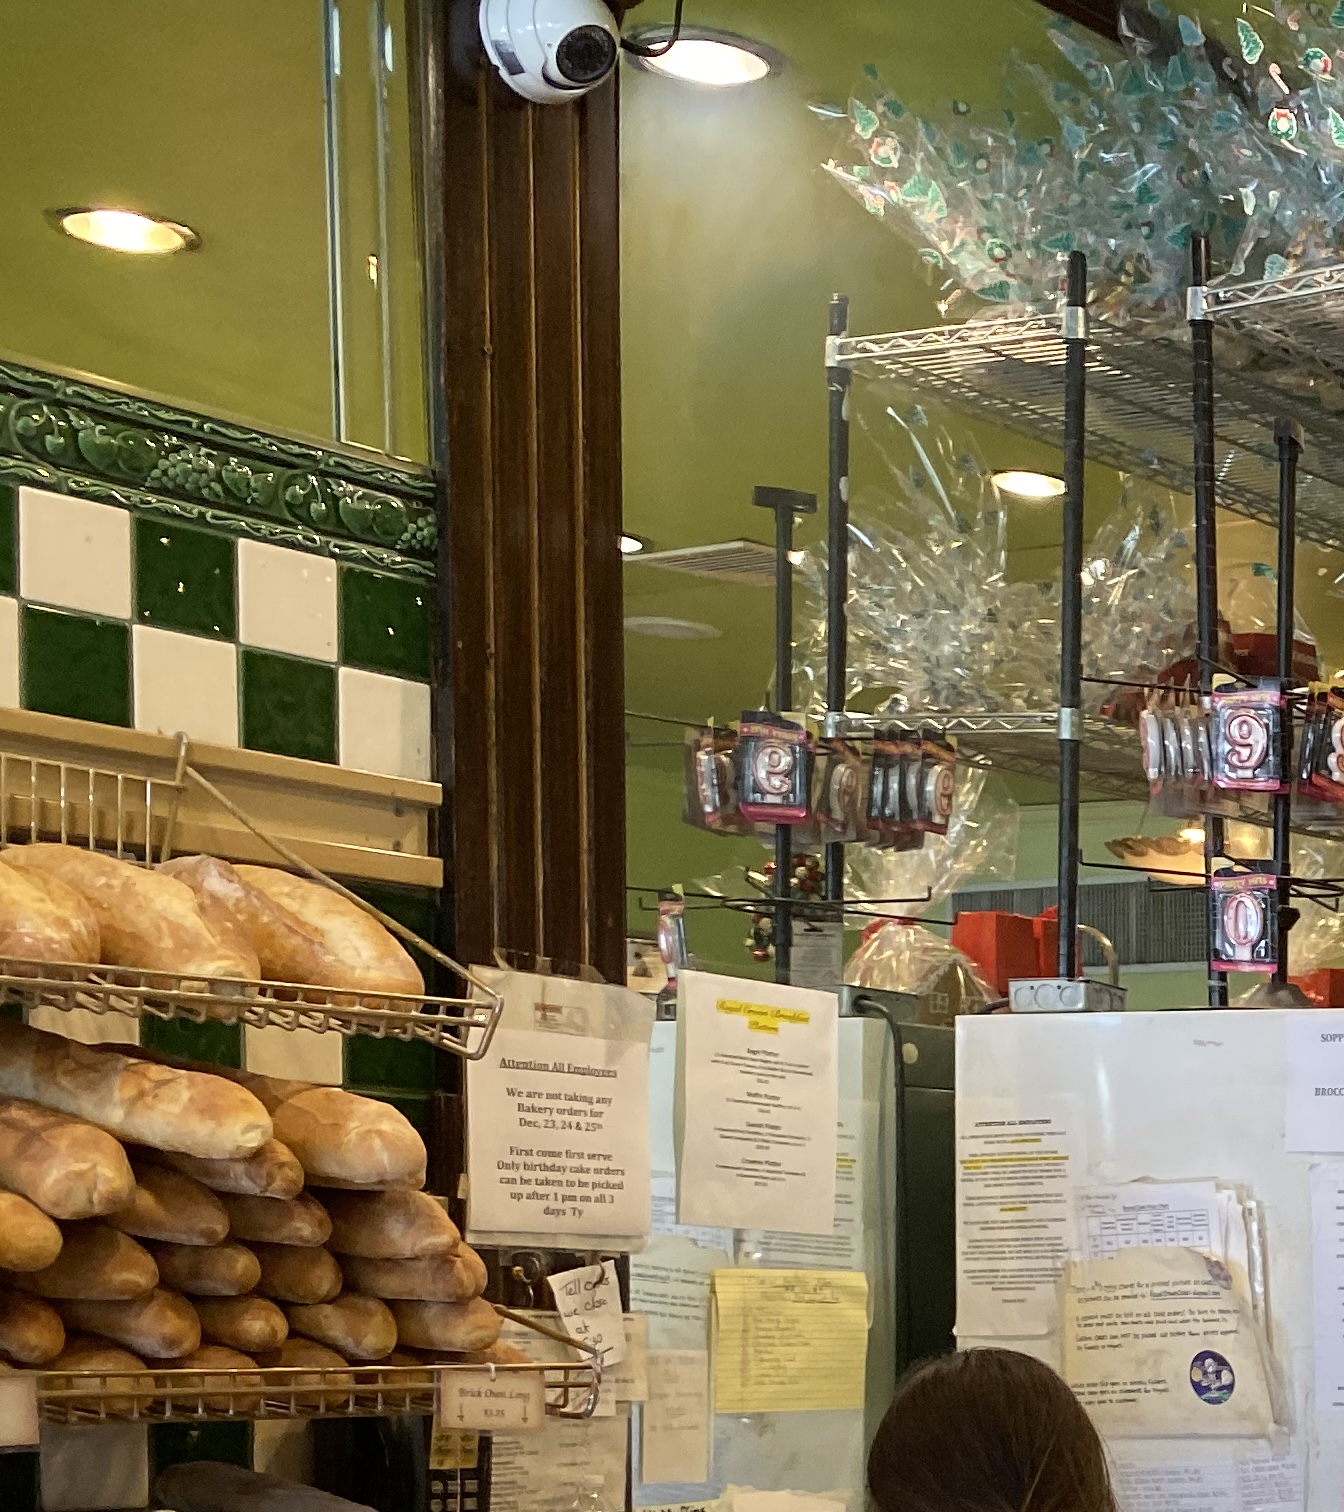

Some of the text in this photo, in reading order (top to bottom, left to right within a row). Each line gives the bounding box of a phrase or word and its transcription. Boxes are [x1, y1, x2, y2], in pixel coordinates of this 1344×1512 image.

[1226, 709, 1268, 770] 9
[500, 1058, 617, 1078] Attention All Employees
[506, 1087, 612, 1107] We are not taking any
[517, 1103, 604, 1118] Bakery orders for
[561, 1120, 572, 1130] 24
[575, 1121, 582, 1131] &
[510, 1146, 613, 1161] First come first serve
[497, 1160, 625, 1176] Only birthday cake orders
[499, 1176, 624, 1191] can be taken to be picked
[510, 1192, 523, 1202] up
[526, 1191, 550, 1201] after
[561, 1194, 577, 1204] pm
[594, 1194, 606, 1204] all
[543, 1206, 584, 1218] days Ty
[560, 1282, 581, 1297] Tell
